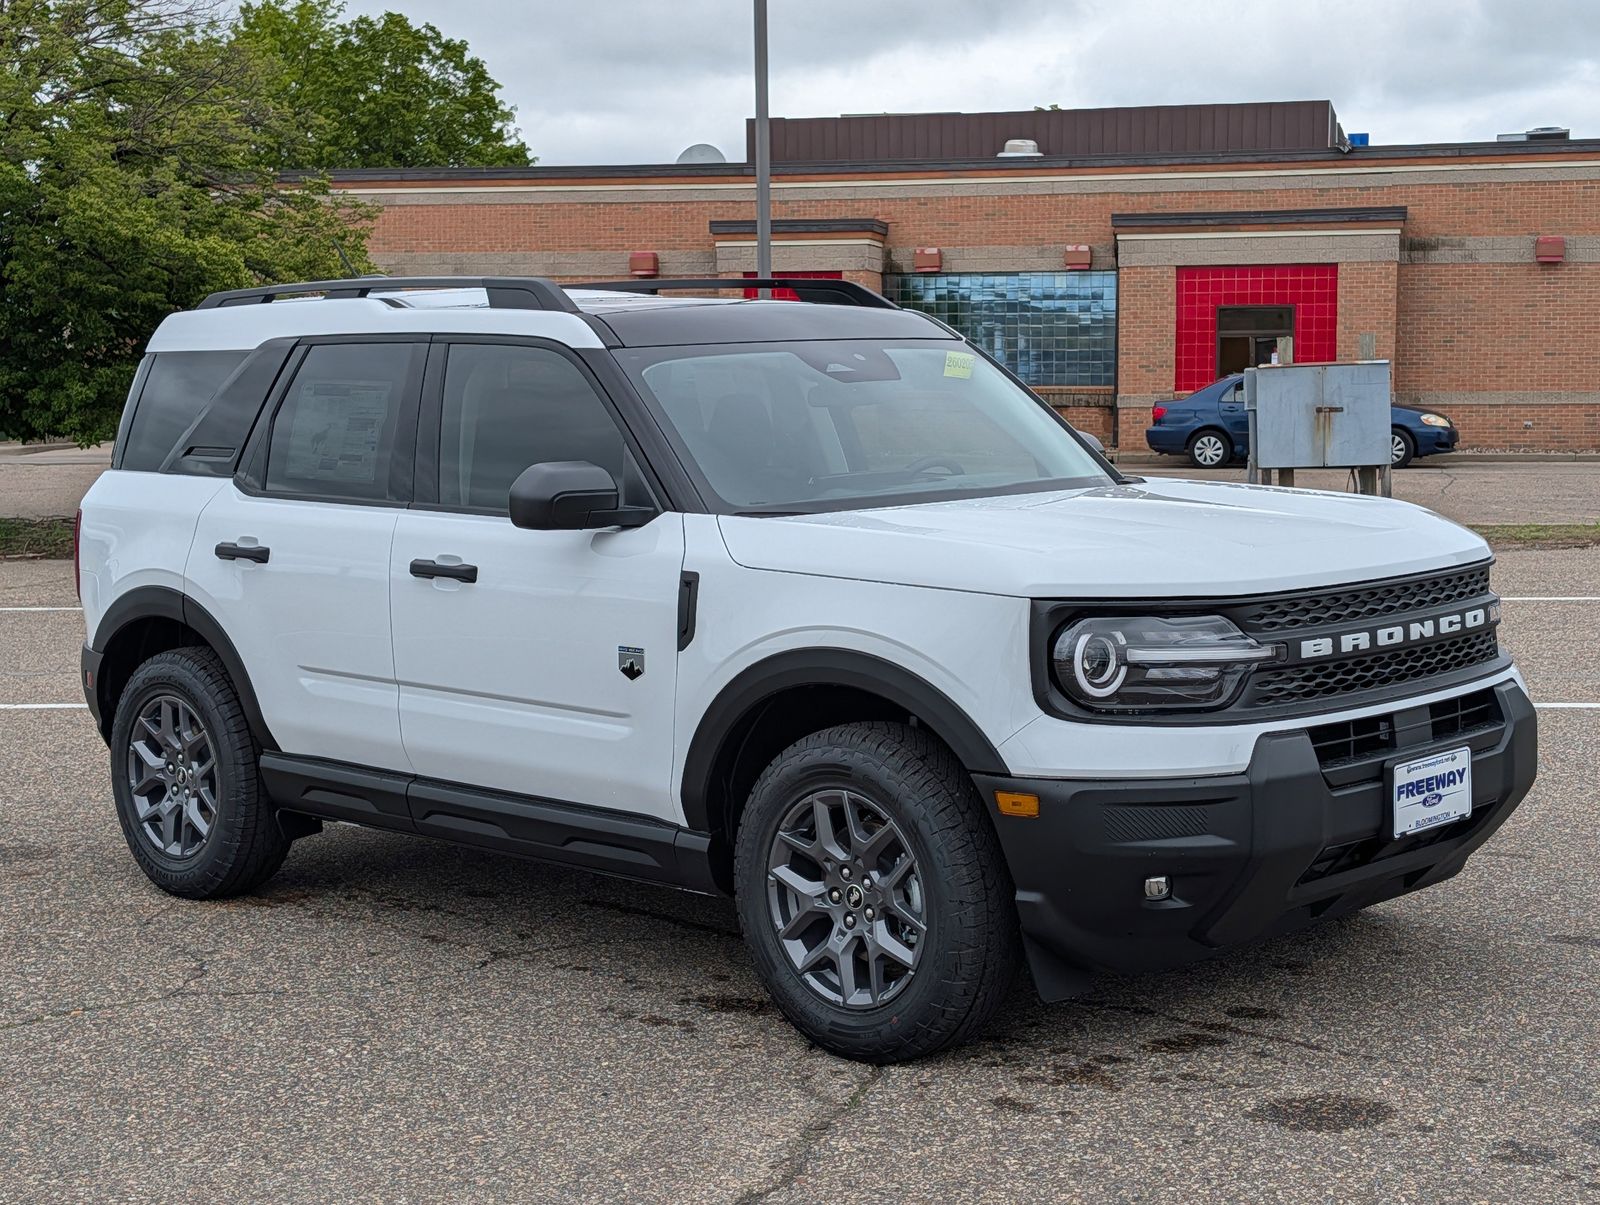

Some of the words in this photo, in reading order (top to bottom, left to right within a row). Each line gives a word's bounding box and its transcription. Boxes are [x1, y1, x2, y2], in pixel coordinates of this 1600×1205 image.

[1301, 608, 1485, 658] BRONCO
[1397, 767, 1466, 802] FREEWAY
[1424, 795, 1440, 807] Ford
[1415, 811, 1451, 828] BLOOMINGTON
